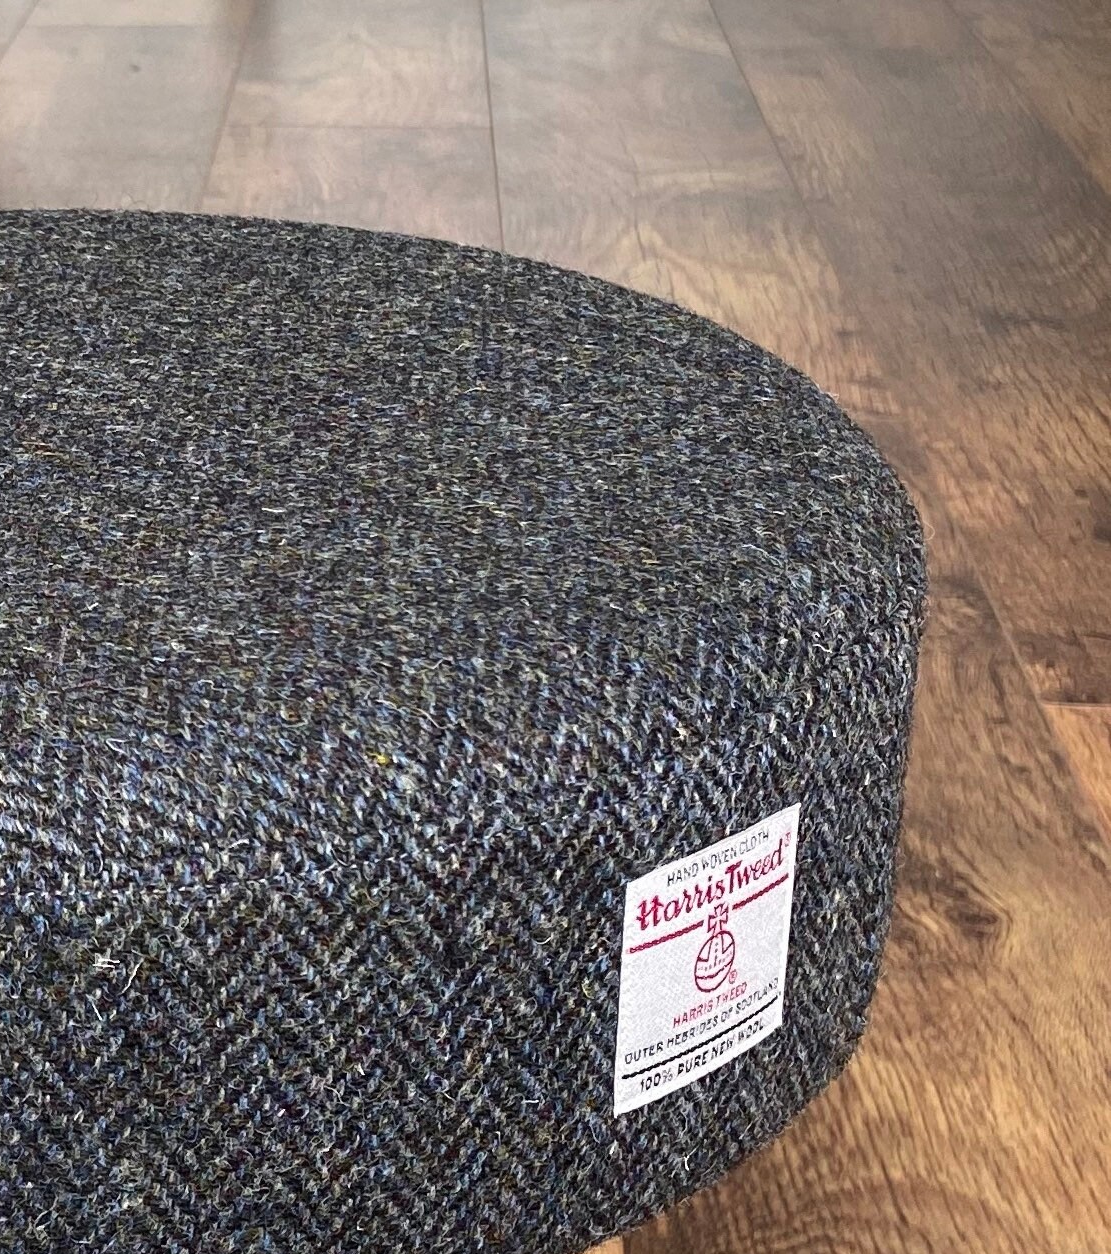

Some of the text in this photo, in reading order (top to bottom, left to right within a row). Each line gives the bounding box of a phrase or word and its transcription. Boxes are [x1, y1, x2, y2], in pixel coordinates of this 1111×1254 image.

[636, 838, 784, 931] Harris Tweed
[667, 829, 770, 887] HAND WOVEN CLOTH
[624, 977, 780, 1065] OUTER HEBRIDES OF SCOTLAND
[672, 982, 748, 1029] HARRIS TWEED
[640, 1018, 765, 1093] 100% PURE NEW WOOL
